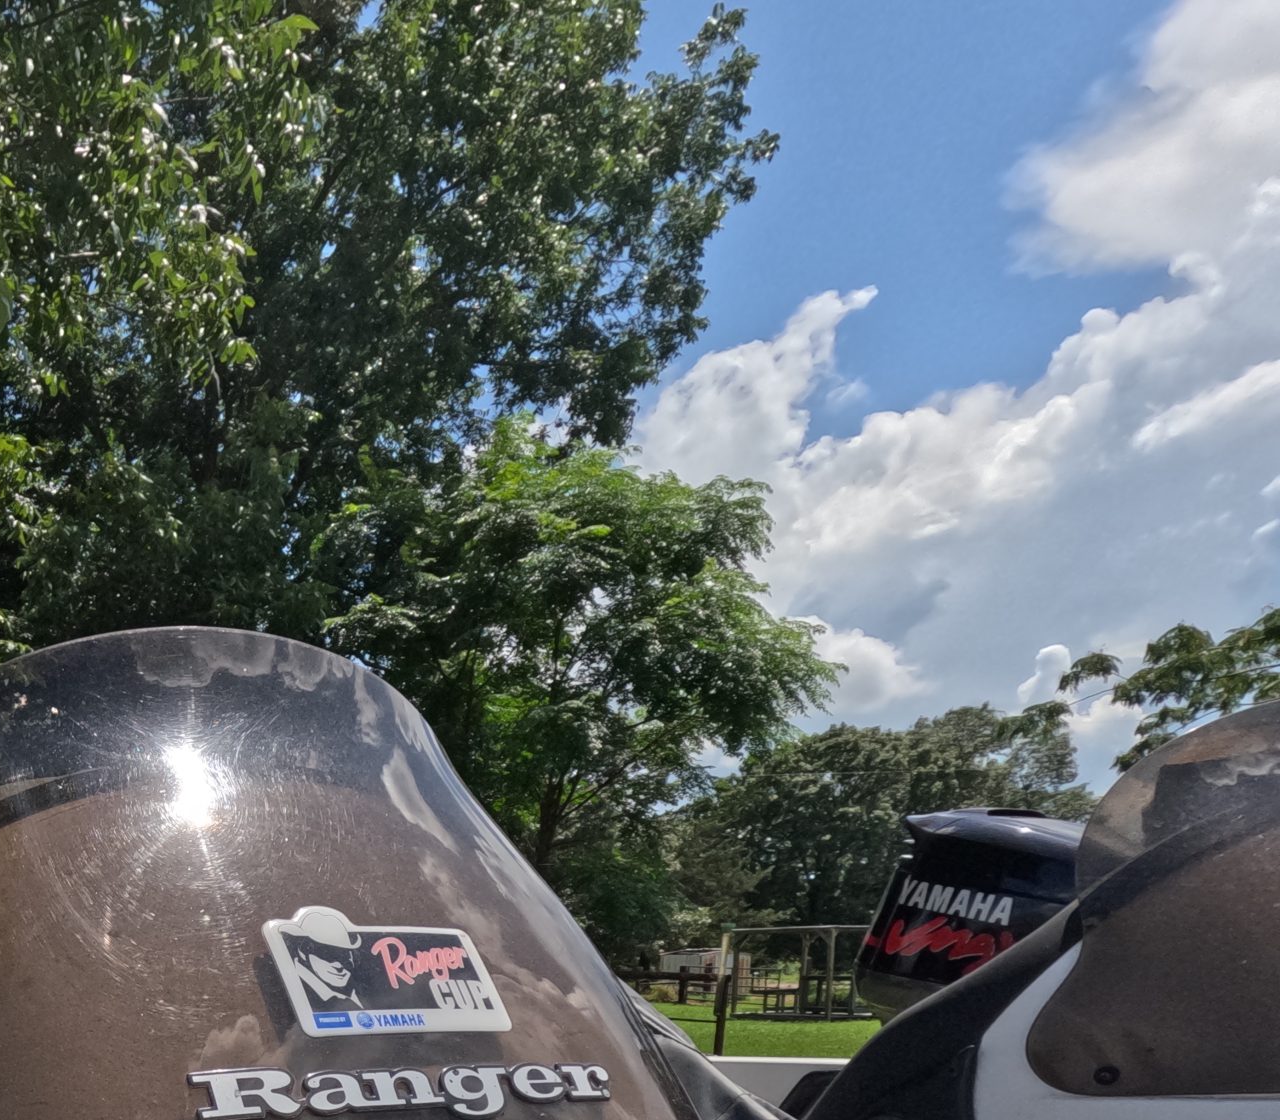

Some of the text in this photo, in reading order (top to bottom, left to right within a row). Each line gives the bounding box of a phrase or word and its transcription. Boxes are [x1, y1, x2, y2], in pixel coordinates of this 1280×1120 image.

[900, 875, 1014, 926] YAMAHA
[371, 936, 468, 989] Ranger
[428, 979, 494, 1010] CUP
[374, 1013, 426, 1028] YAMAHA
